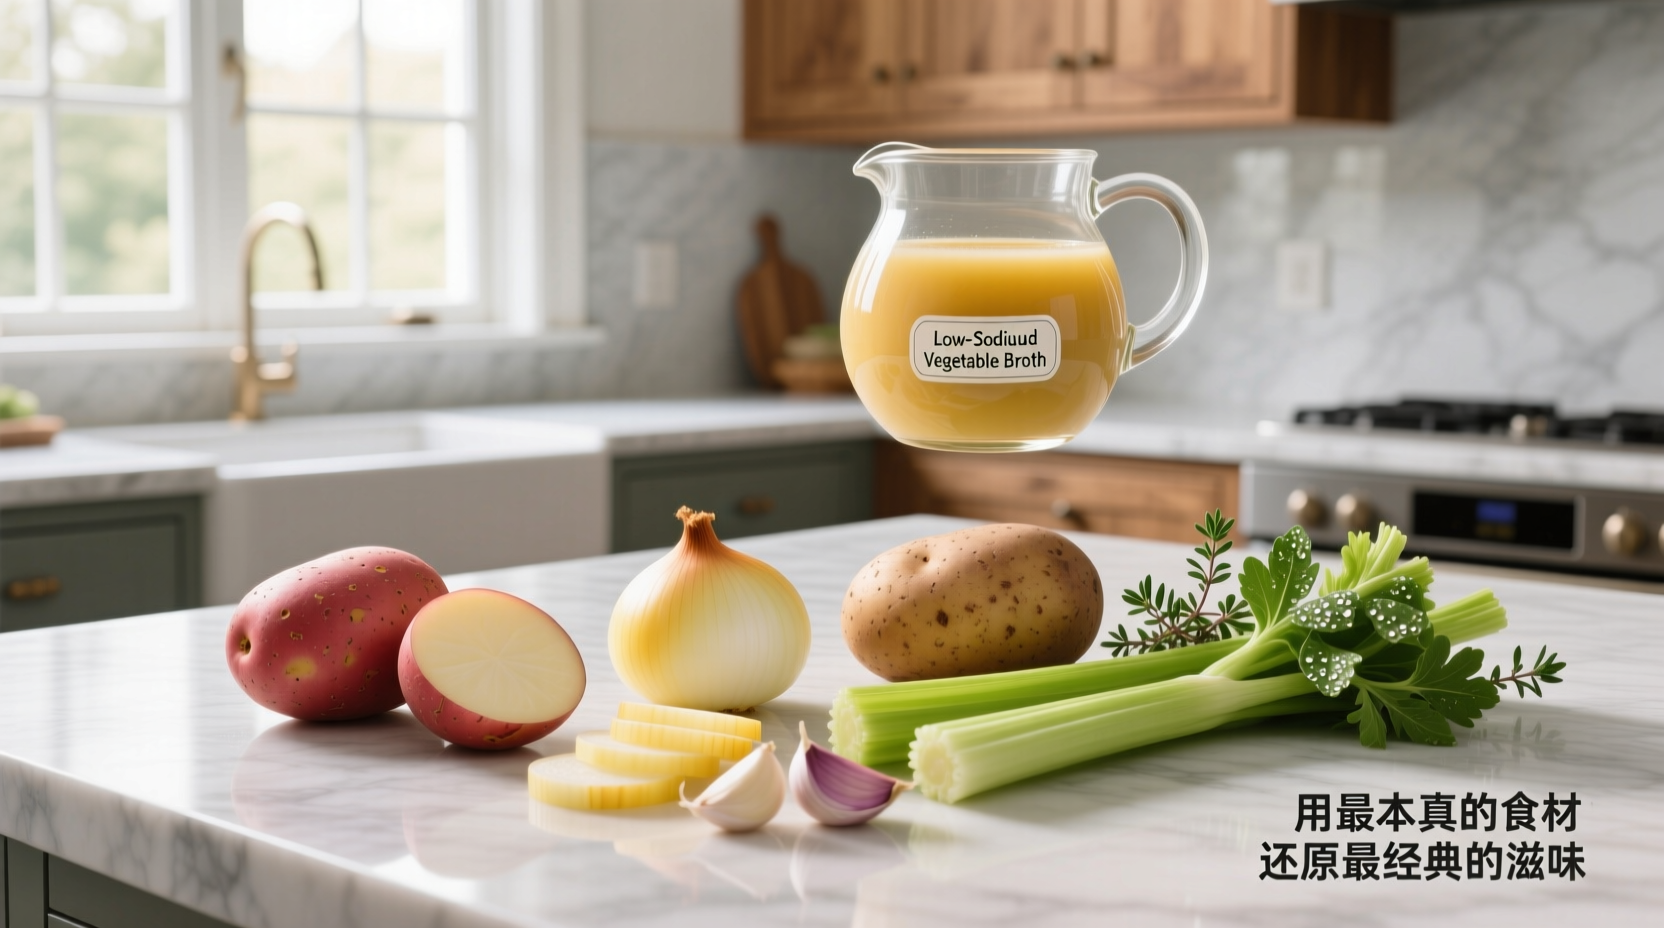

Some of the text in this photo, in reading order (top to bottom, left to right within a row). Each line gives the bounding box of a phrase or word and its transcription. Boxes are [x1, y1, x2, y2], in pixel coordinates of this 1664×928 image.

[933, 328, 1038, 347] Low-Sodiuud
[923, 350, 1047, 372] Vegetable Broth
